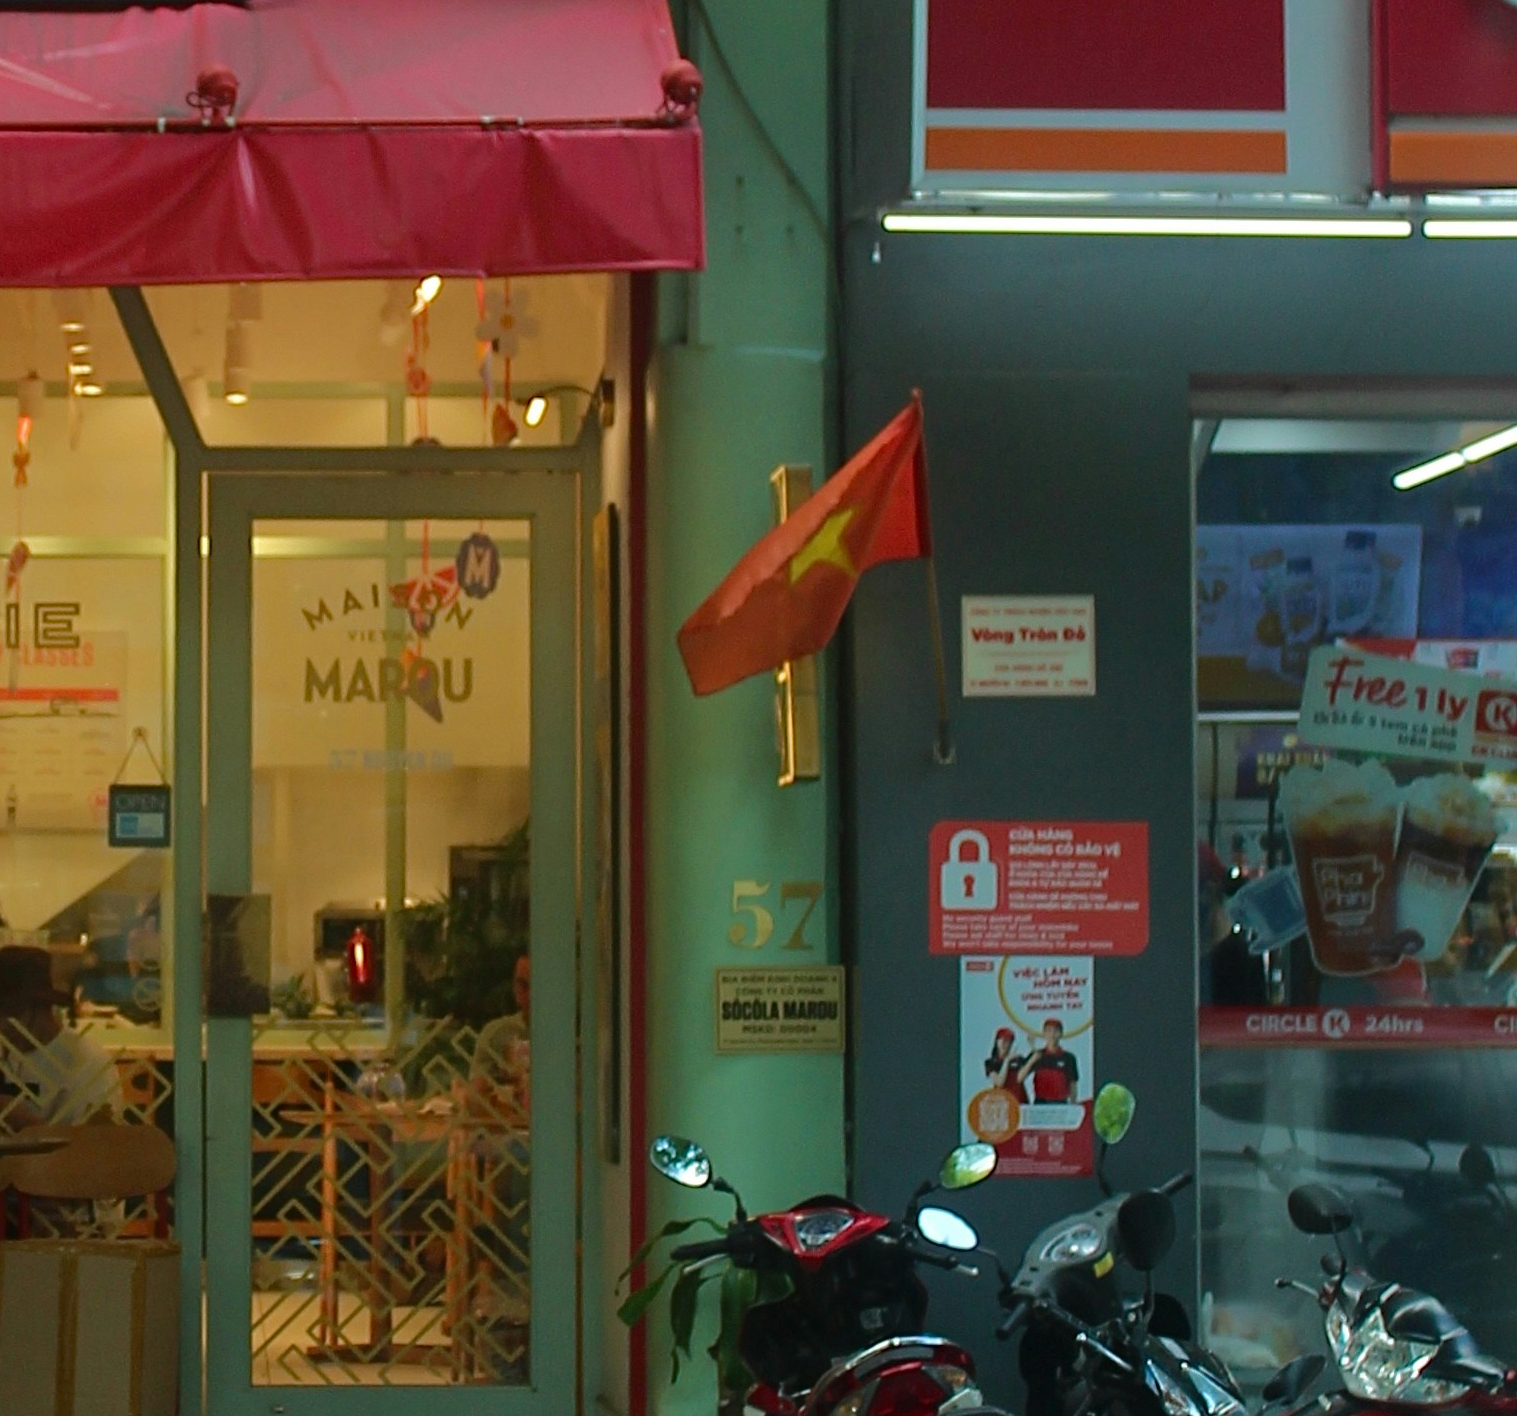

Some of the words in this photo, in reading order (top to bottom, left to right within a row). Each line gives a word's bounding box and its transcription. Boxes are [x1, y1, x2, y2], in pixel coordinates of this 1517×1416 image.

[304, 657, 473, 703] MAROU
[1322, 655, 1408, 708] Free
[1415, 687, 1429, 712] 1
[1437, 686, 1469, 721] ly
[728, 880, 825, 951] 57
[783, 1000, 838, 1021] MAROU
[1245, 1014, 1316, 1033] CIRCLE
[1364, 1014, 1424, 1034] 24hrs
